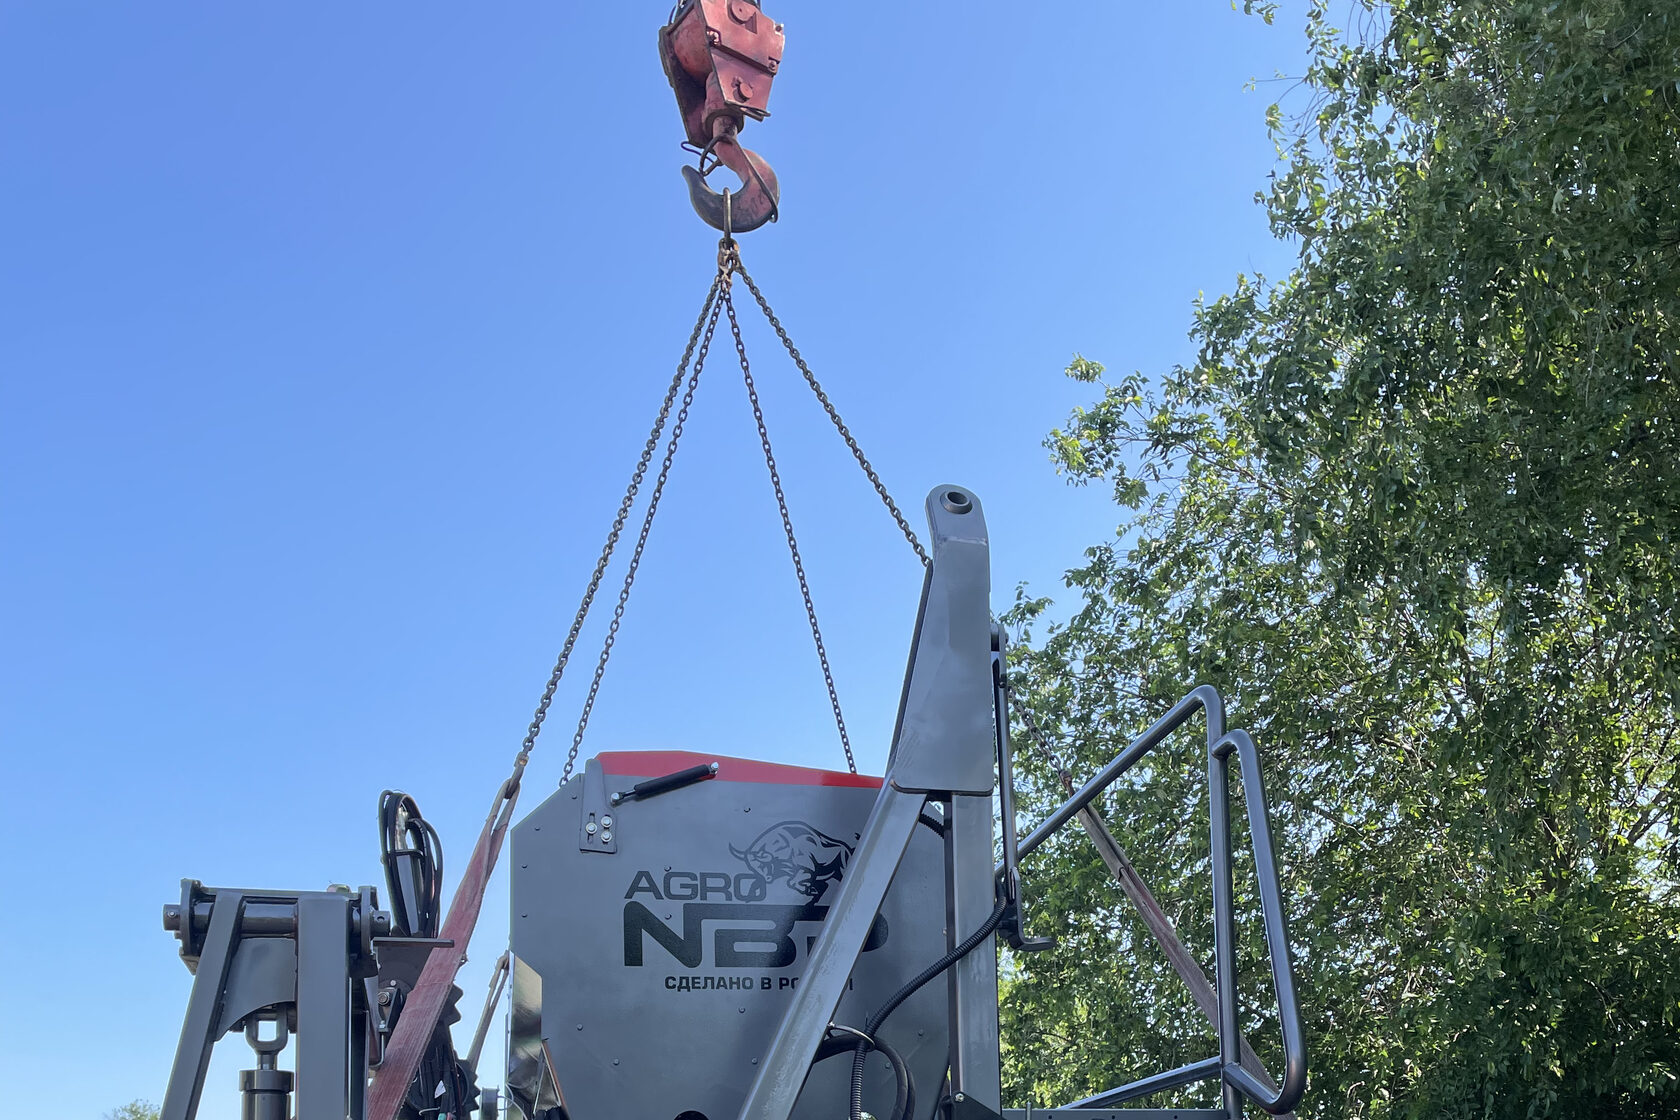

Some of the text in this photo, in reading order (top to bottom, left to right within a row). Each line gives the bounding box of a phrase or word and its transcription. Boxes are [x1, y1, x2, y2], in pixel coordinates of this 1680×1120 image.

[624, 870, 767, 901] AGRO
[664, 976, 754, 992] СДЕЛАНО
[760, 977, 772, 990] В
